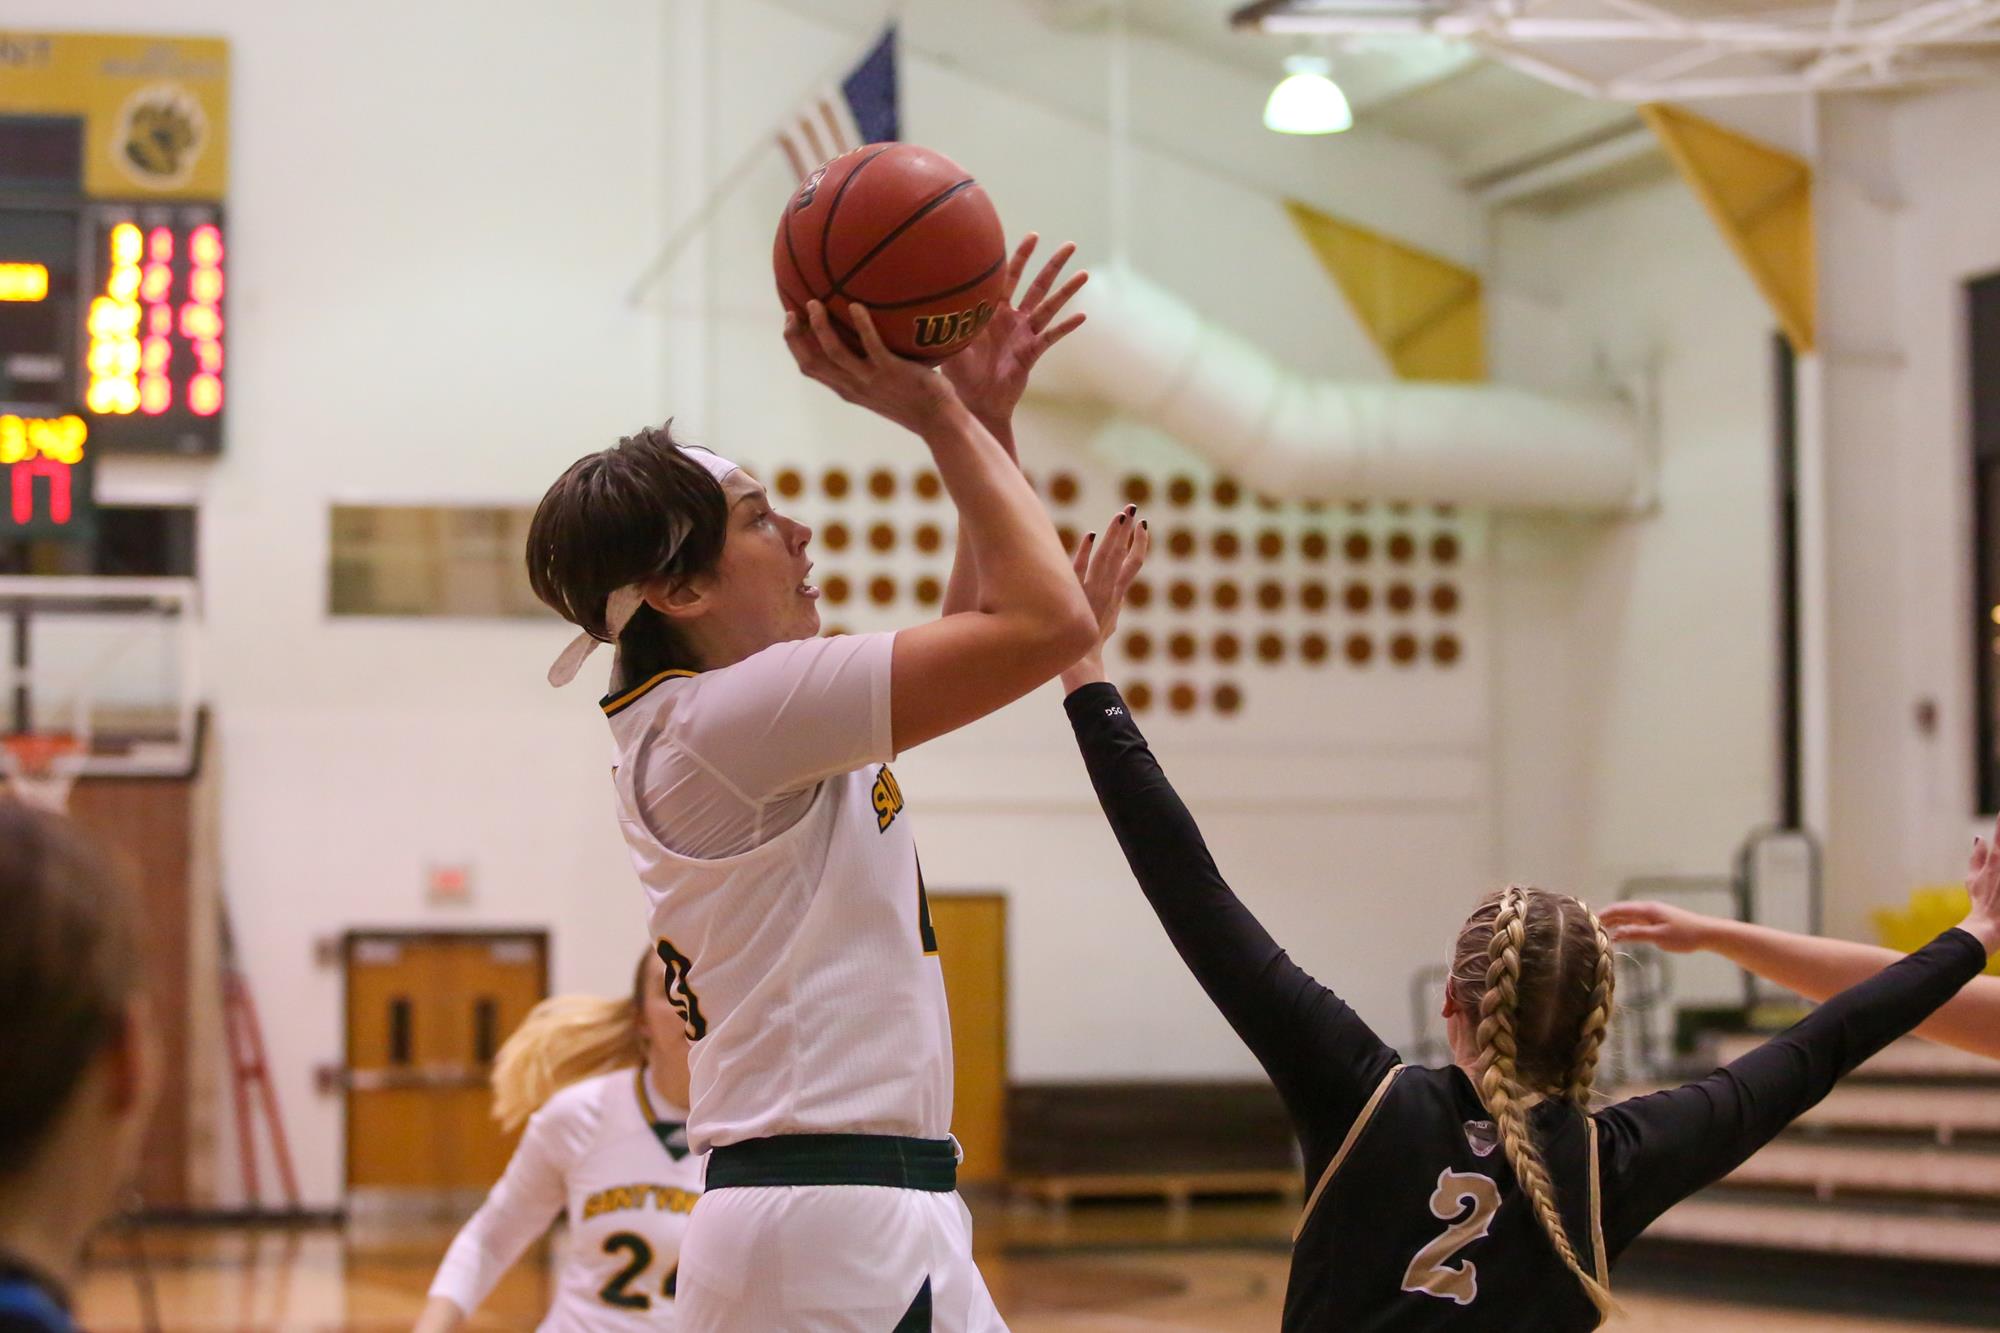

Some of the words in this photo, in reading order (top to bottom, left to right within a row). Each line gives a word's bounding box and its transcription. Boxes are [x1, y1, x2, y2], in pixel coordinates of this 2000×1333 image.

[1105, 706, 1123, 716] DSG
[599, 1230, 677, 1312] 2
[1401, 1166, 1502, 1305] 2
